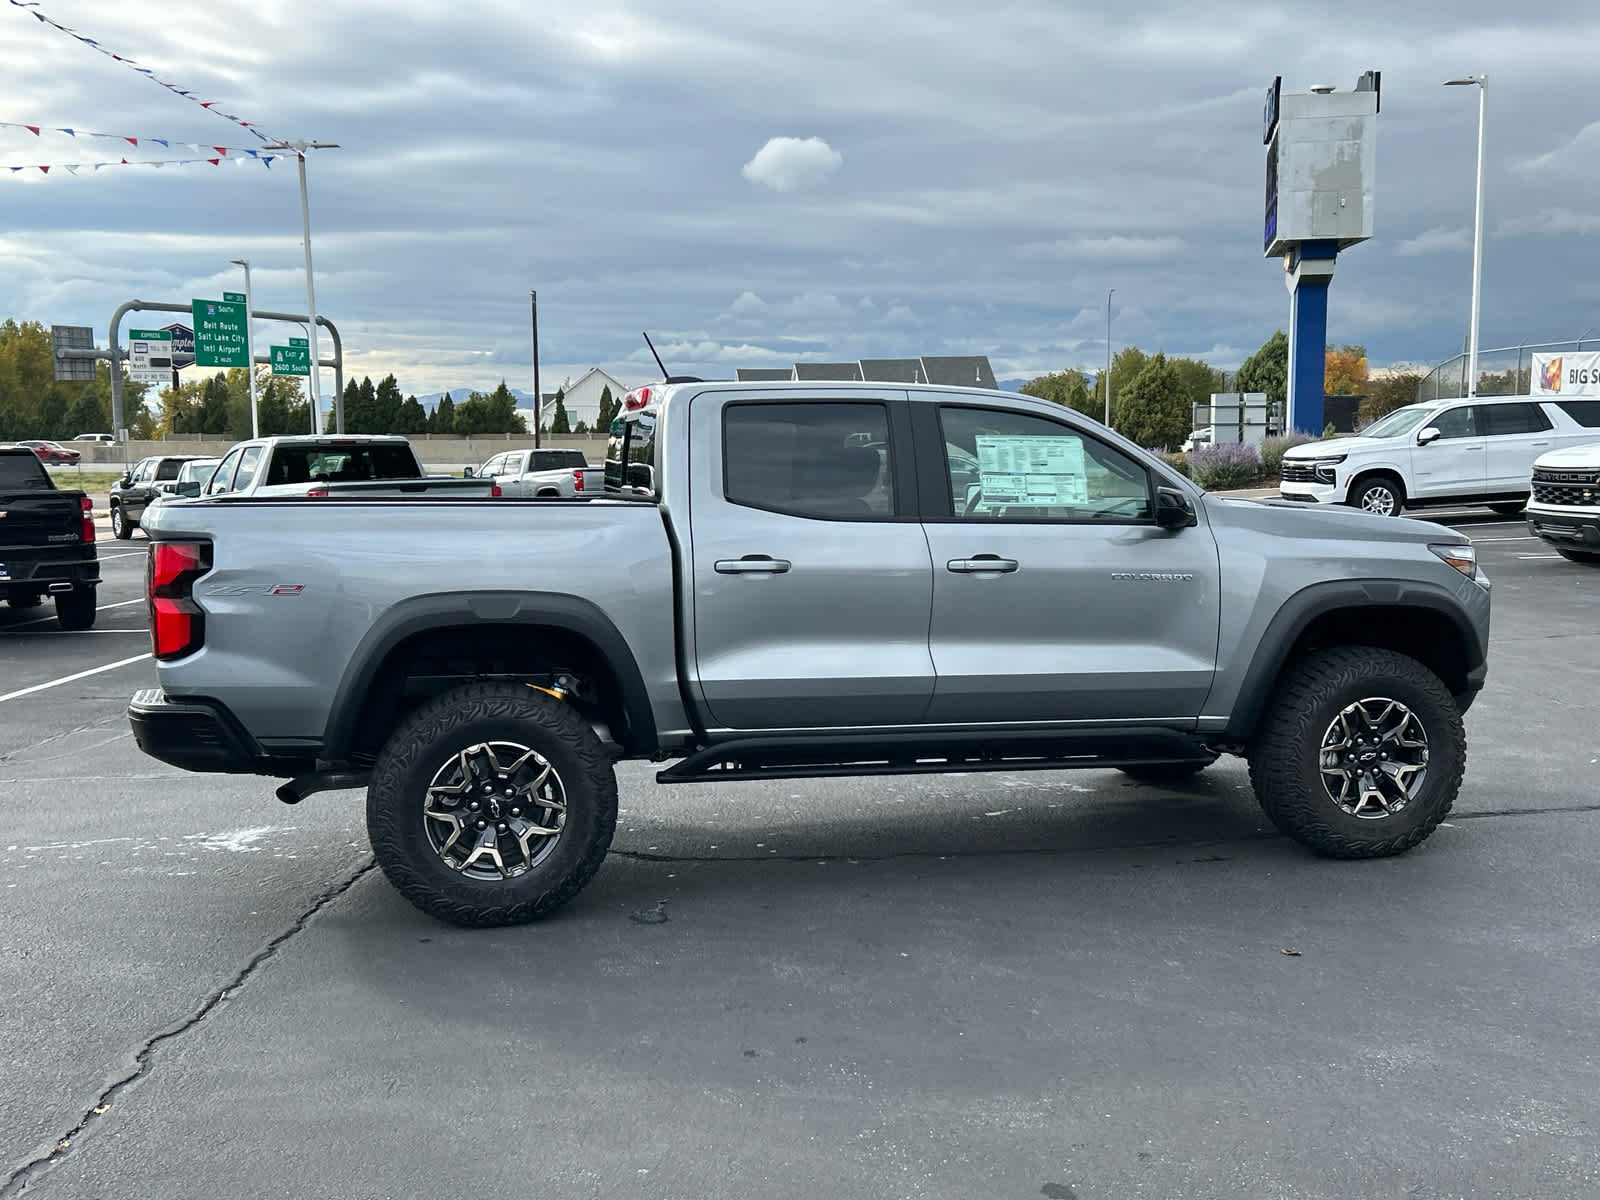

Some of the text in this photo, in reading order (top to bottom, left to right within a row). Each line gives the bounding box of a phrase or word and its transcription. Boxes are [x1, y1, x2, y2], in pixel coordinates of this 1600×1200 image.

[203, 320, 239, 331] Belt Route
[197, 332, 245, 344] Salt Lake City
[203, 344, 216, 353] Intl
[218, 344, 241, 355] Airport
[213, 355, 219, 364] 2
[274, 363, 308, 372] 2600 South
[1569, 368, 1600, 385] BIG S
[1111, 572, 1193, 582] COLORADO
[203, 584, 305, 597] ZR2
